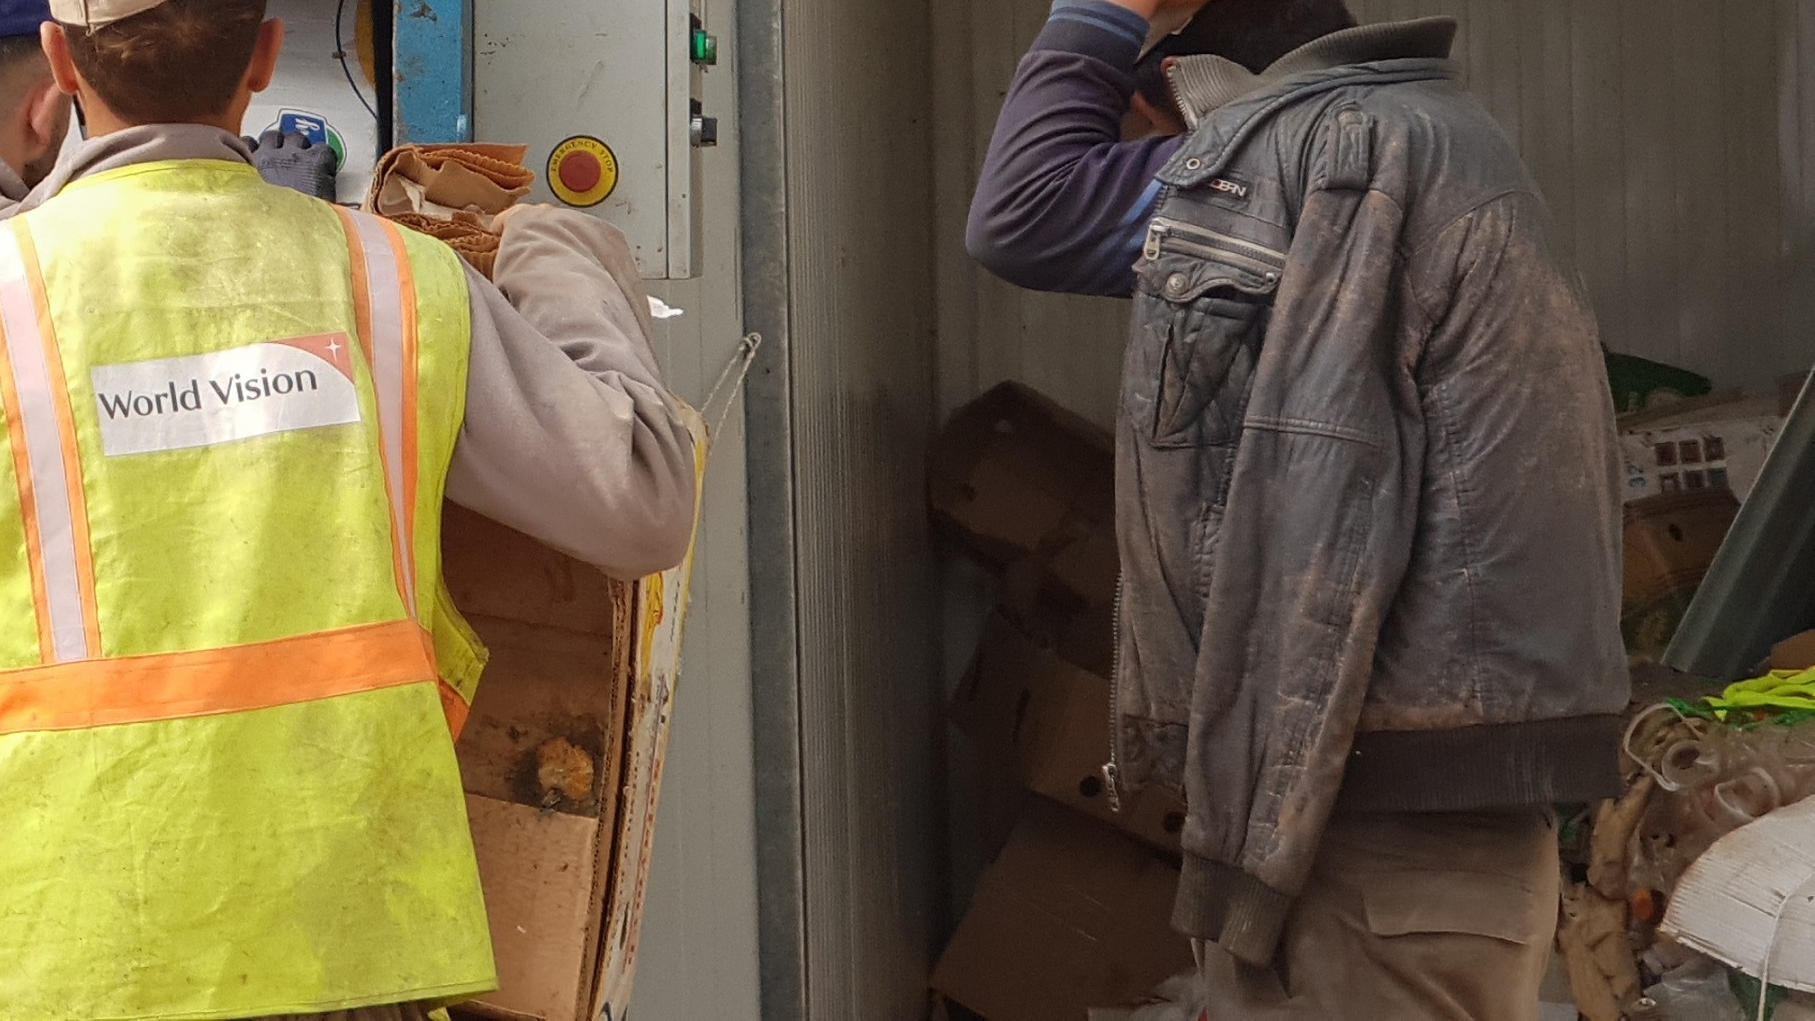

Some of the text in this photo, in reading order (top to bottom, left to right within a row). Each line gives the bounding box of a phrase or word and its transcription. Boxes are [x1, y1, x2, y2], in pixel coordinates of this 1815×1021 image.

[551, 140, 614, 173] EMERGENCY STOP
[98, 367, 318, 420] World Vision
